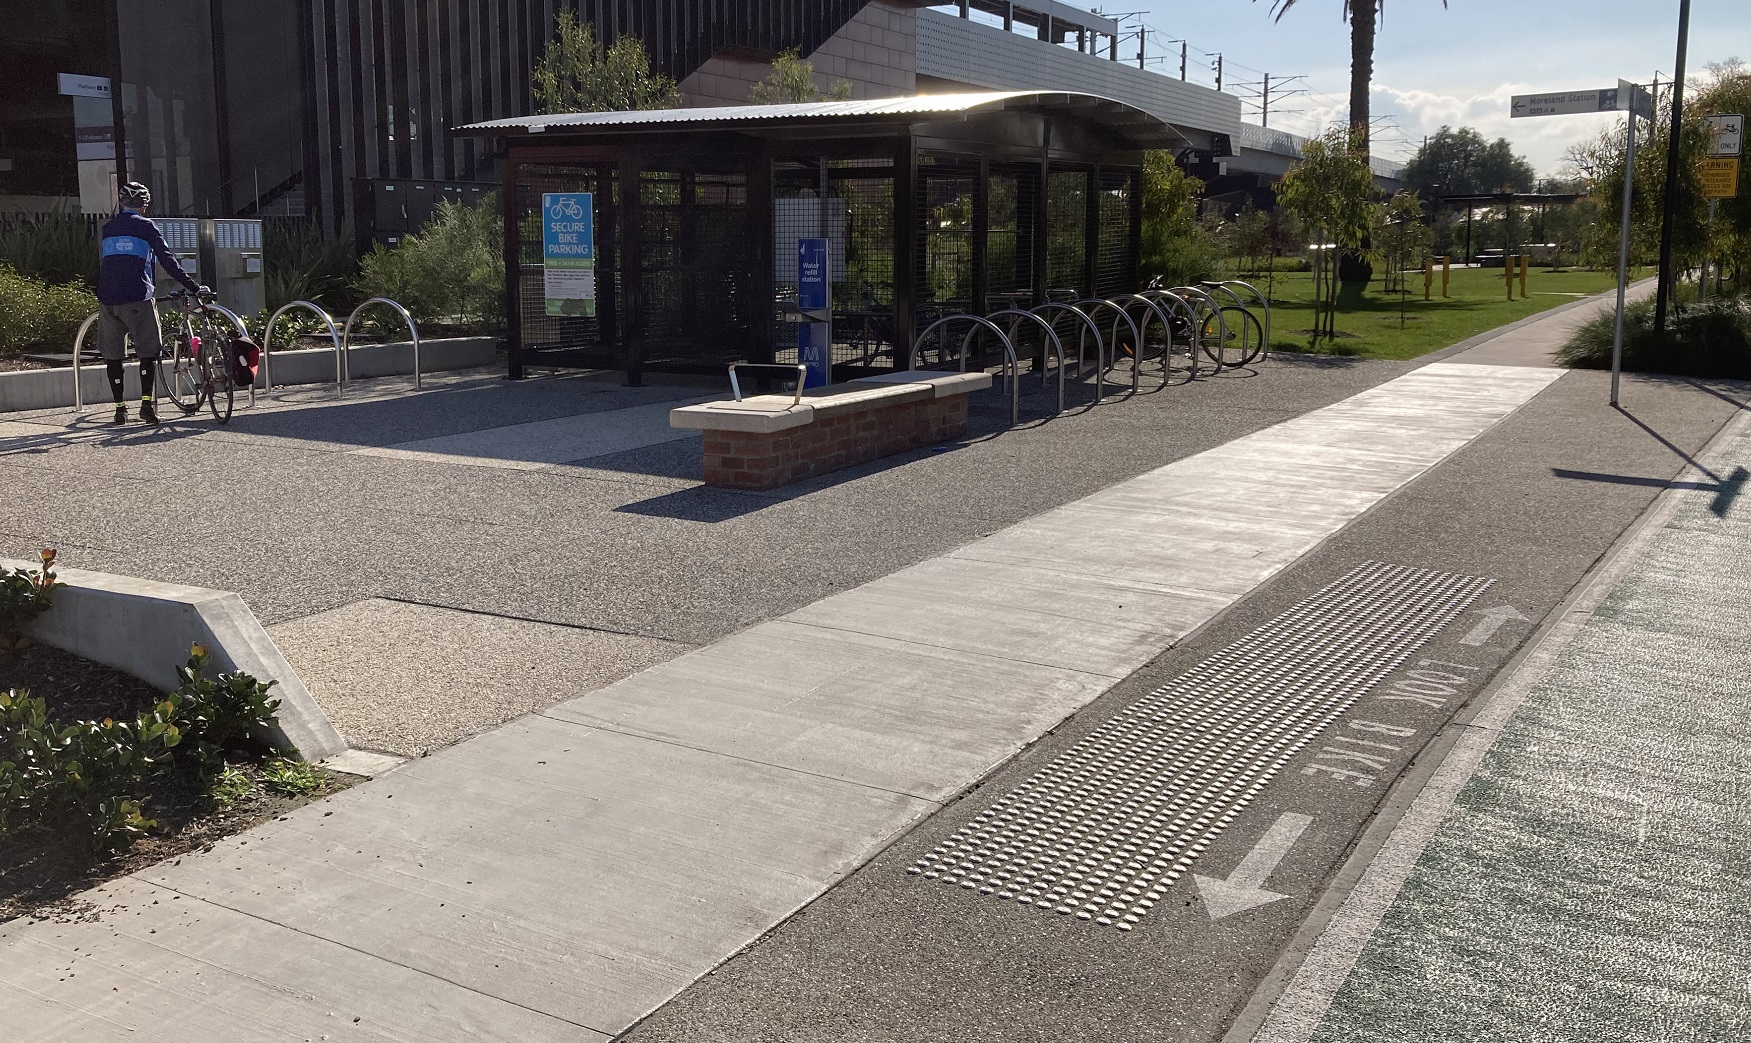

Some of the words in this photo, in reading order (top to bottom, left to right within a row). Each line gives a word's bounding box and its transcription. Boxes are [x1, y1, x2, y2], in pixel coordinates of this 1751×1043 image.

[1530, 95, 1565, 105] Moreland
[1568, 93, 1596, 101] Station
[1704, 161, 1734, 169] ARNING
[551, 222, 585, 232] SECURE
[558, 233, 578, 243] BIKE
[548, 244, 588, 254] PARKING
[1378, 658, 1480, 708] LOOK
[1300, 719, 1417, 788] BIKE
